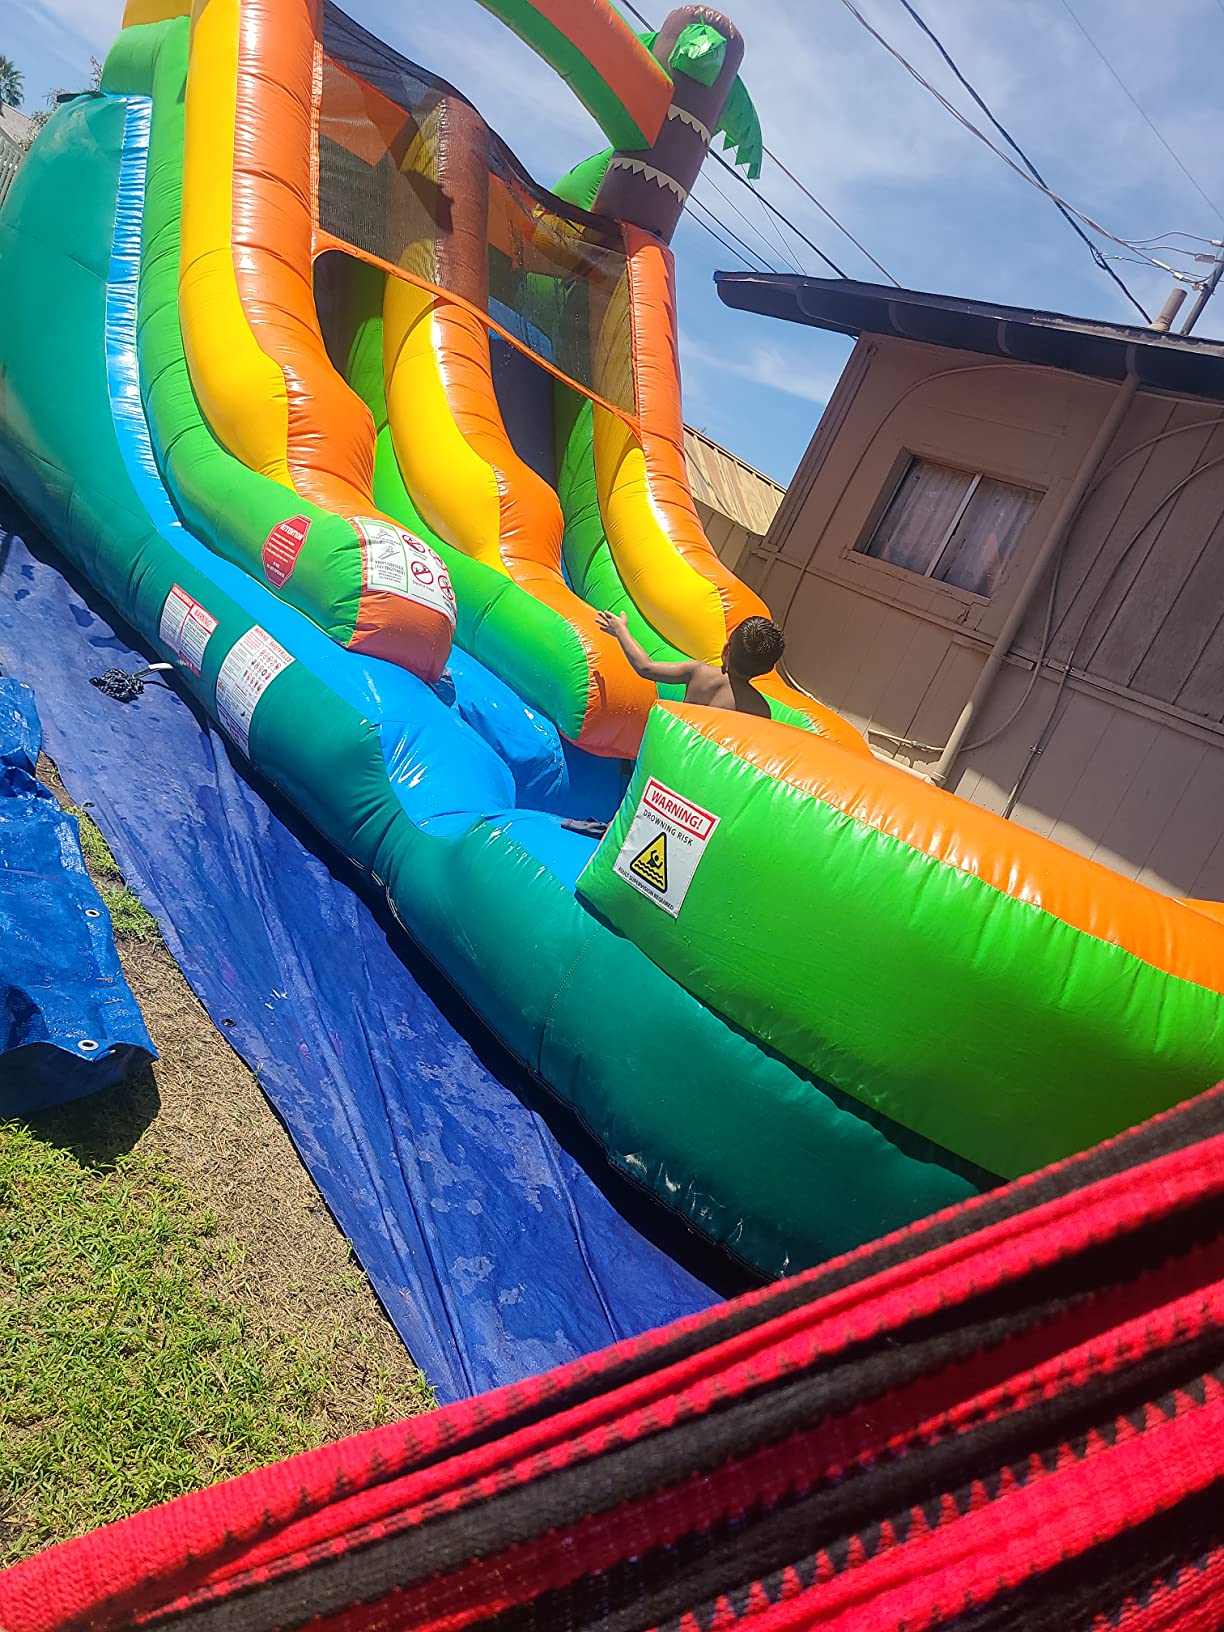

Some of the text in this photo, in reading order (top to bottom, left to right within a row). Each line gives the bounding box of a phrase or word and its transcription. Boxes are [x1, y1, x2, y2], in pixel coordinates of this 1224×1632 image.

[643, 809, 694, 846] DROWNING RISK
[651, 790, 704, 830] WARNING!
